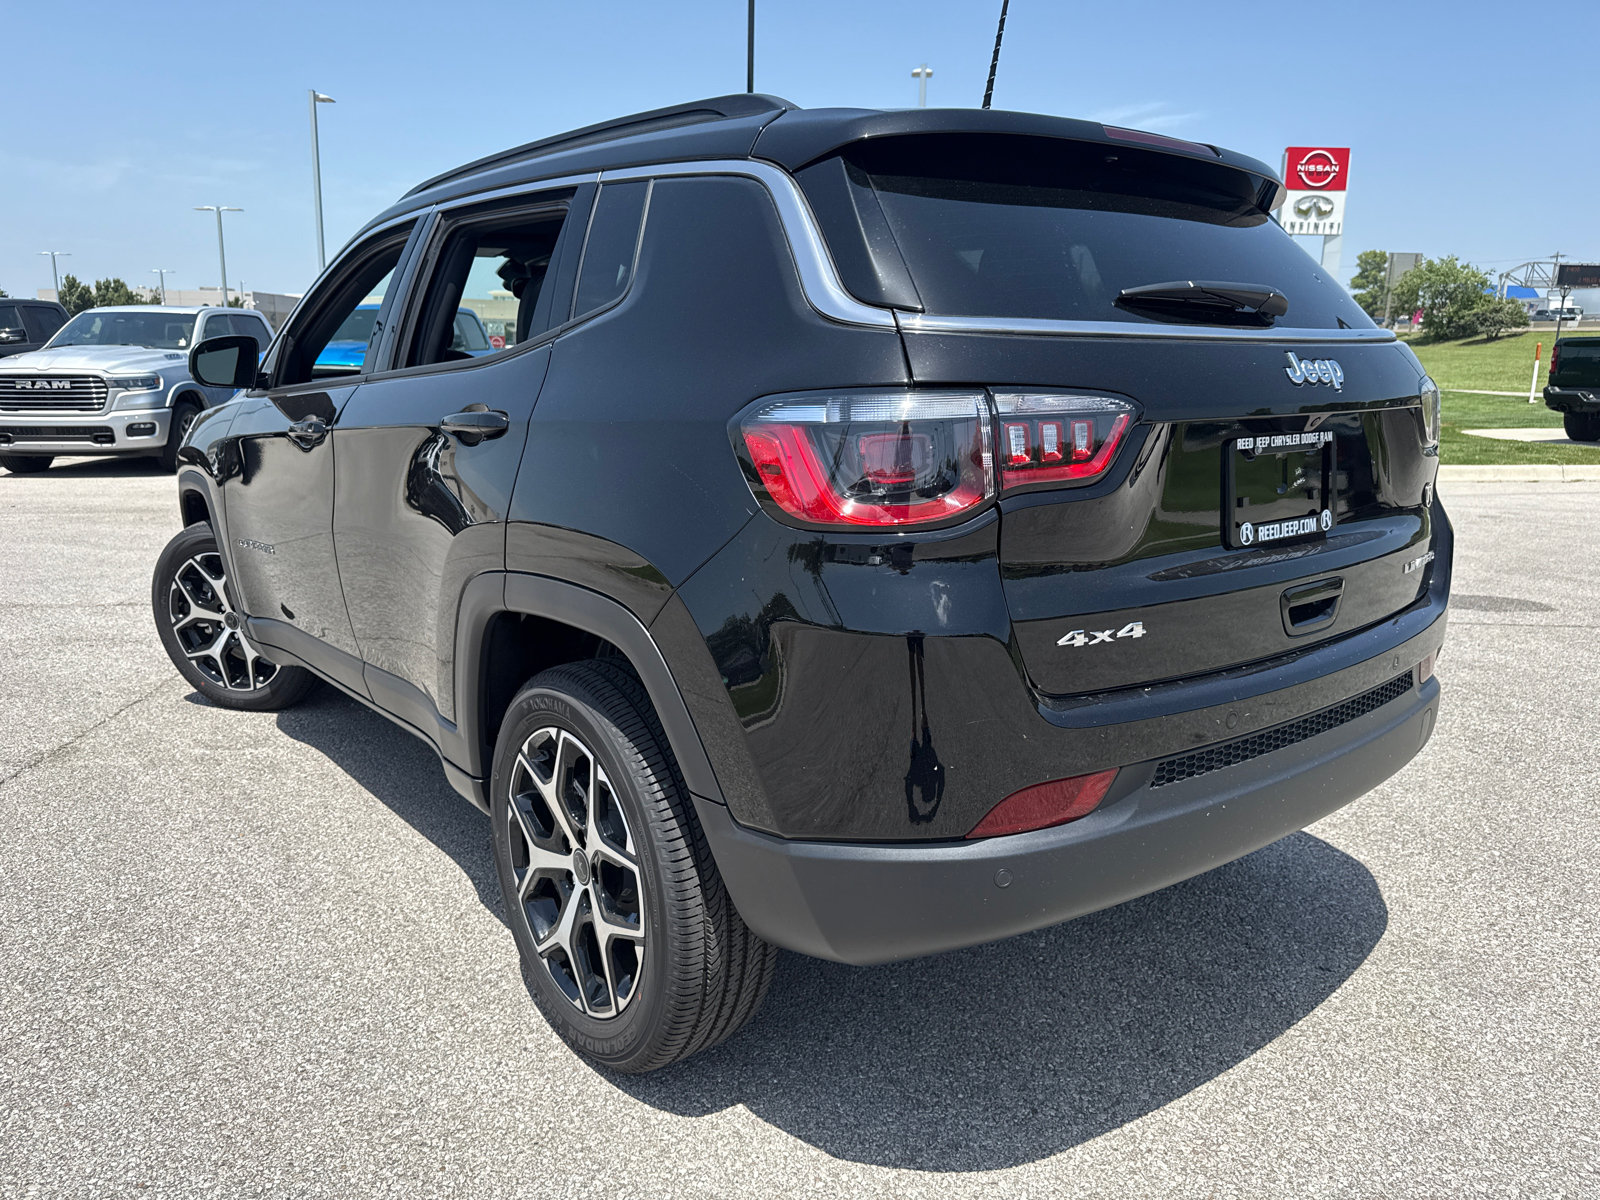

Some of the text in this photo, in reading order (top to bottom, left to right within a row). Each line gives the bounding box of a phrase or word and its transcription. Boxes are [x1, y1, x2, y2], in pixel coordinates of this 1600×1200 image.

[1297, 164, 1339, 172] NISSAN
[1283, 221, 1341, 234] INFINITI
[1285, 351, 1344, 389] Jeep
[15, 380, 71, 389] RAM
[1236, 430, 1333, 450] REED JEEP CHRYSLER DODGE RAM
[1258, 517, 1317, 541] REEDJEEP.COM
[1056, 621, 1147, 647] 4x4
[529, 697, 571, 720] YOKOHAMA
